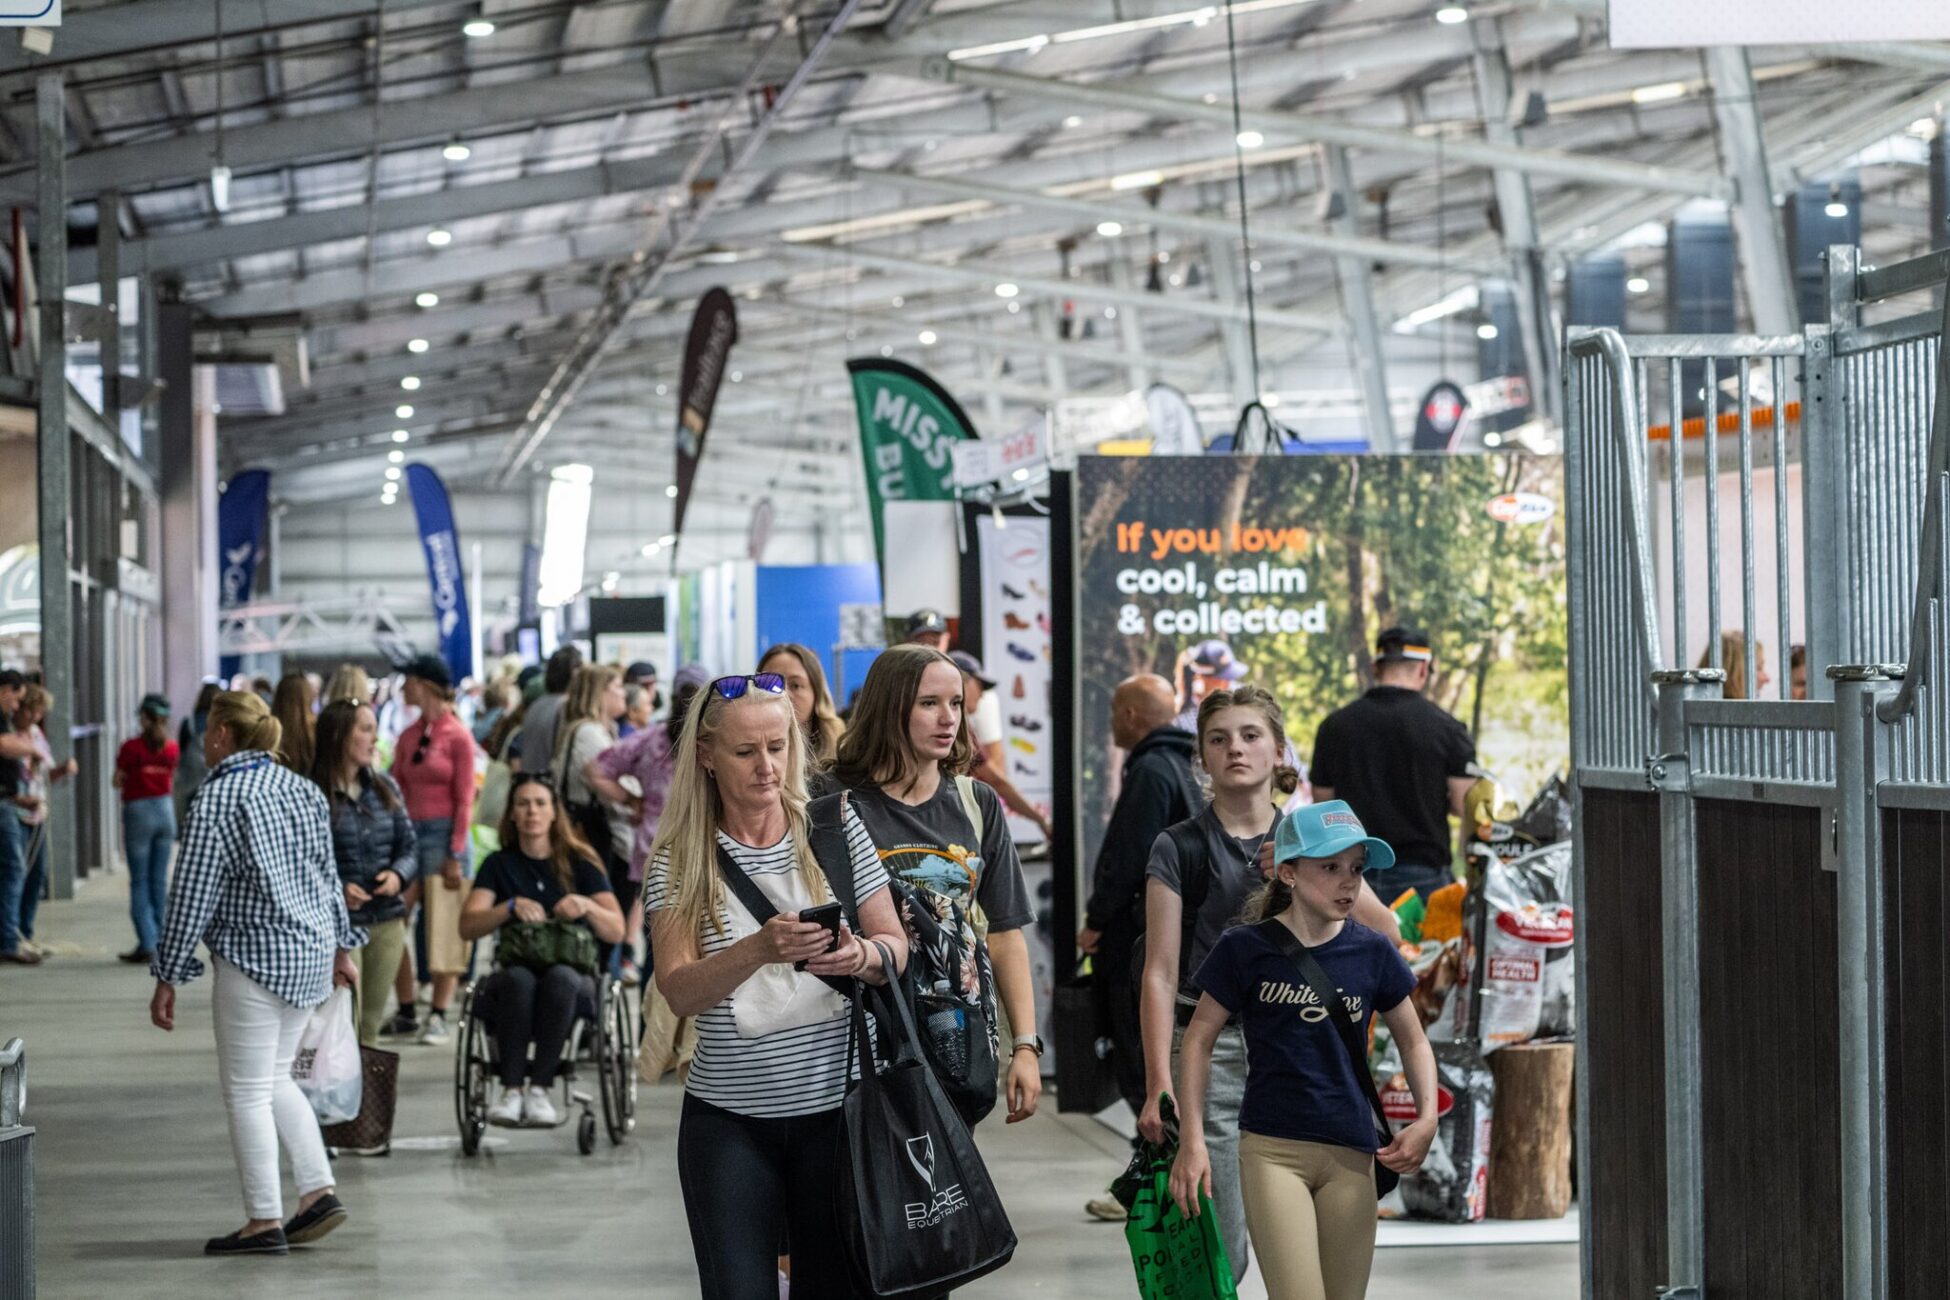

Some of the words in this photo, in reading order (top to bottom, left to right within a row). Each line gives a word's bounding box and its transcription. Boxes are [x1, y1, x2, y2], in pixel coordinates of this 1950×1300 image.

[873, 386, 957, 491] MISS
[1116, 520, 1145, 553] If
[1151, 527, 1221, 560] you
[1232, 521, 1308, 553] love
[1115, 560, 1208, 600] cool,
[1214, 560, 1308, 595] calm
[1117, 603, 1146, 636] &
[1153, 601, 1327, 636] collected
[1259, 981, 1321, 1005] White
[904, 1183, 965, 1221] BARE
[907, 1200, 969, 1230] EQUETRIAN
